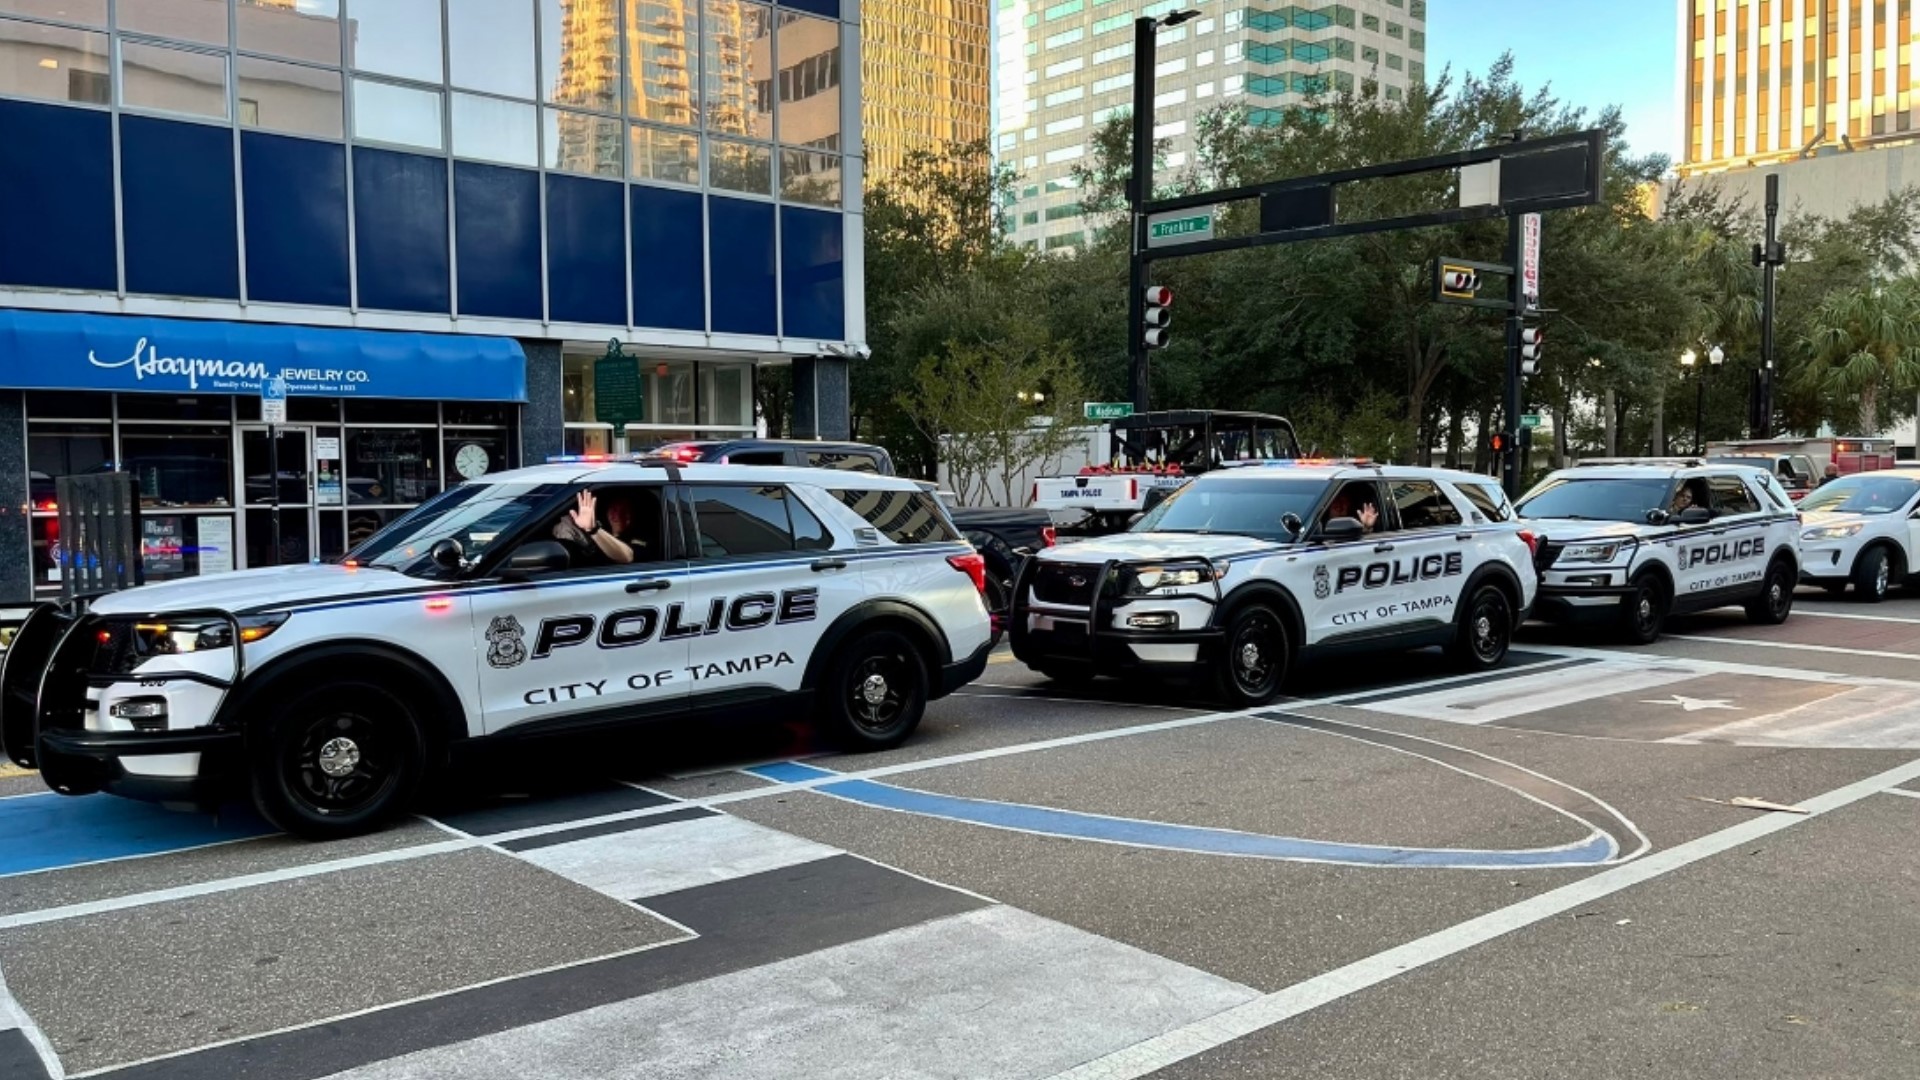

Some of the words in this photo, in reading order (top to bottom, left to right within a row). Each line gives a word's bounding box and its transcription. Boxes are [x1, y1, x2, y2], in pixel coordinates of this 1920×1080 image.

[1161, 221, 1195, 235] Franklin
[89, 337, 269, 390] Hayman
[278, 367, 343, 382] JEWELRY
[346, 369, 370, 383] CO.
[213, 380, 239, 391] Family
[1096, 405, 1122, 417] Madison
[1061, 489, 1080, 498] TAMPA
[1081, 488, 1102, 497] POLICE
[1688, 536, 1765, 568] POLICE
[1334, 551, 1463, 594] POLICE
[1689, 578, 1712, 591] CITY
[1714, 576, 1728, 587] OF
[1731, 570, 1762, 583] TAMPA
[530, 584, 820, 660] POLICE
[1331, 609, 1369, 626] CITY
[1376, 604, 1398, 619] OF
[1401, 594, 1454, 613] TAMPA
[523, 678, 608, 705] CITY
[627, 669, 674, 690] OF
[684, 650, 795, 681] TAMPA
